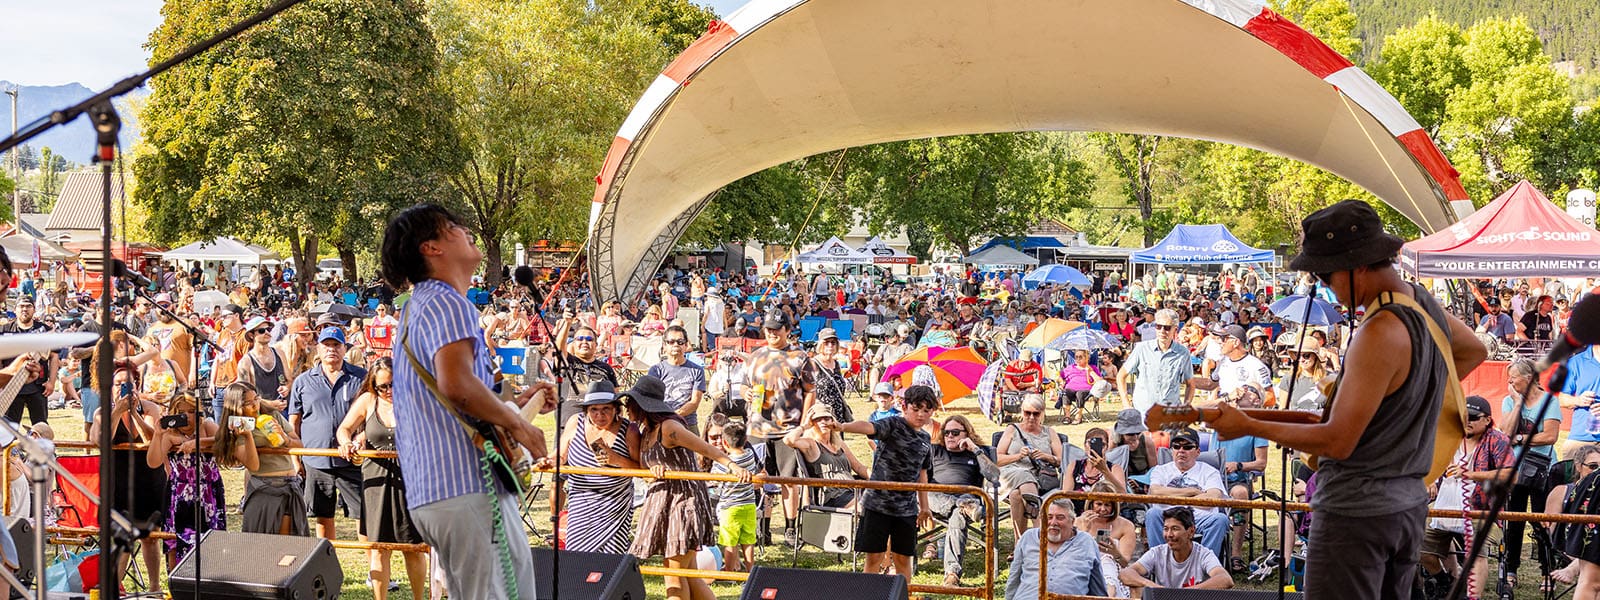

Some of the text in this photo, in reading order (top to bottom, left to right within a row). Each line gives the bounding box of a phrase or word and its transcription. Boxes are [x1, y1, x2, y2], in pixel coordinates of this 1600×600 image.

[1476, 231, 1591, 244] SIGHT SOUND
[1166, 244, 1208, 252] Rotary
[1166, 254, 1191, 262] Rotary
[1478, 260, 1585, 270] ENTERTAINMENT
